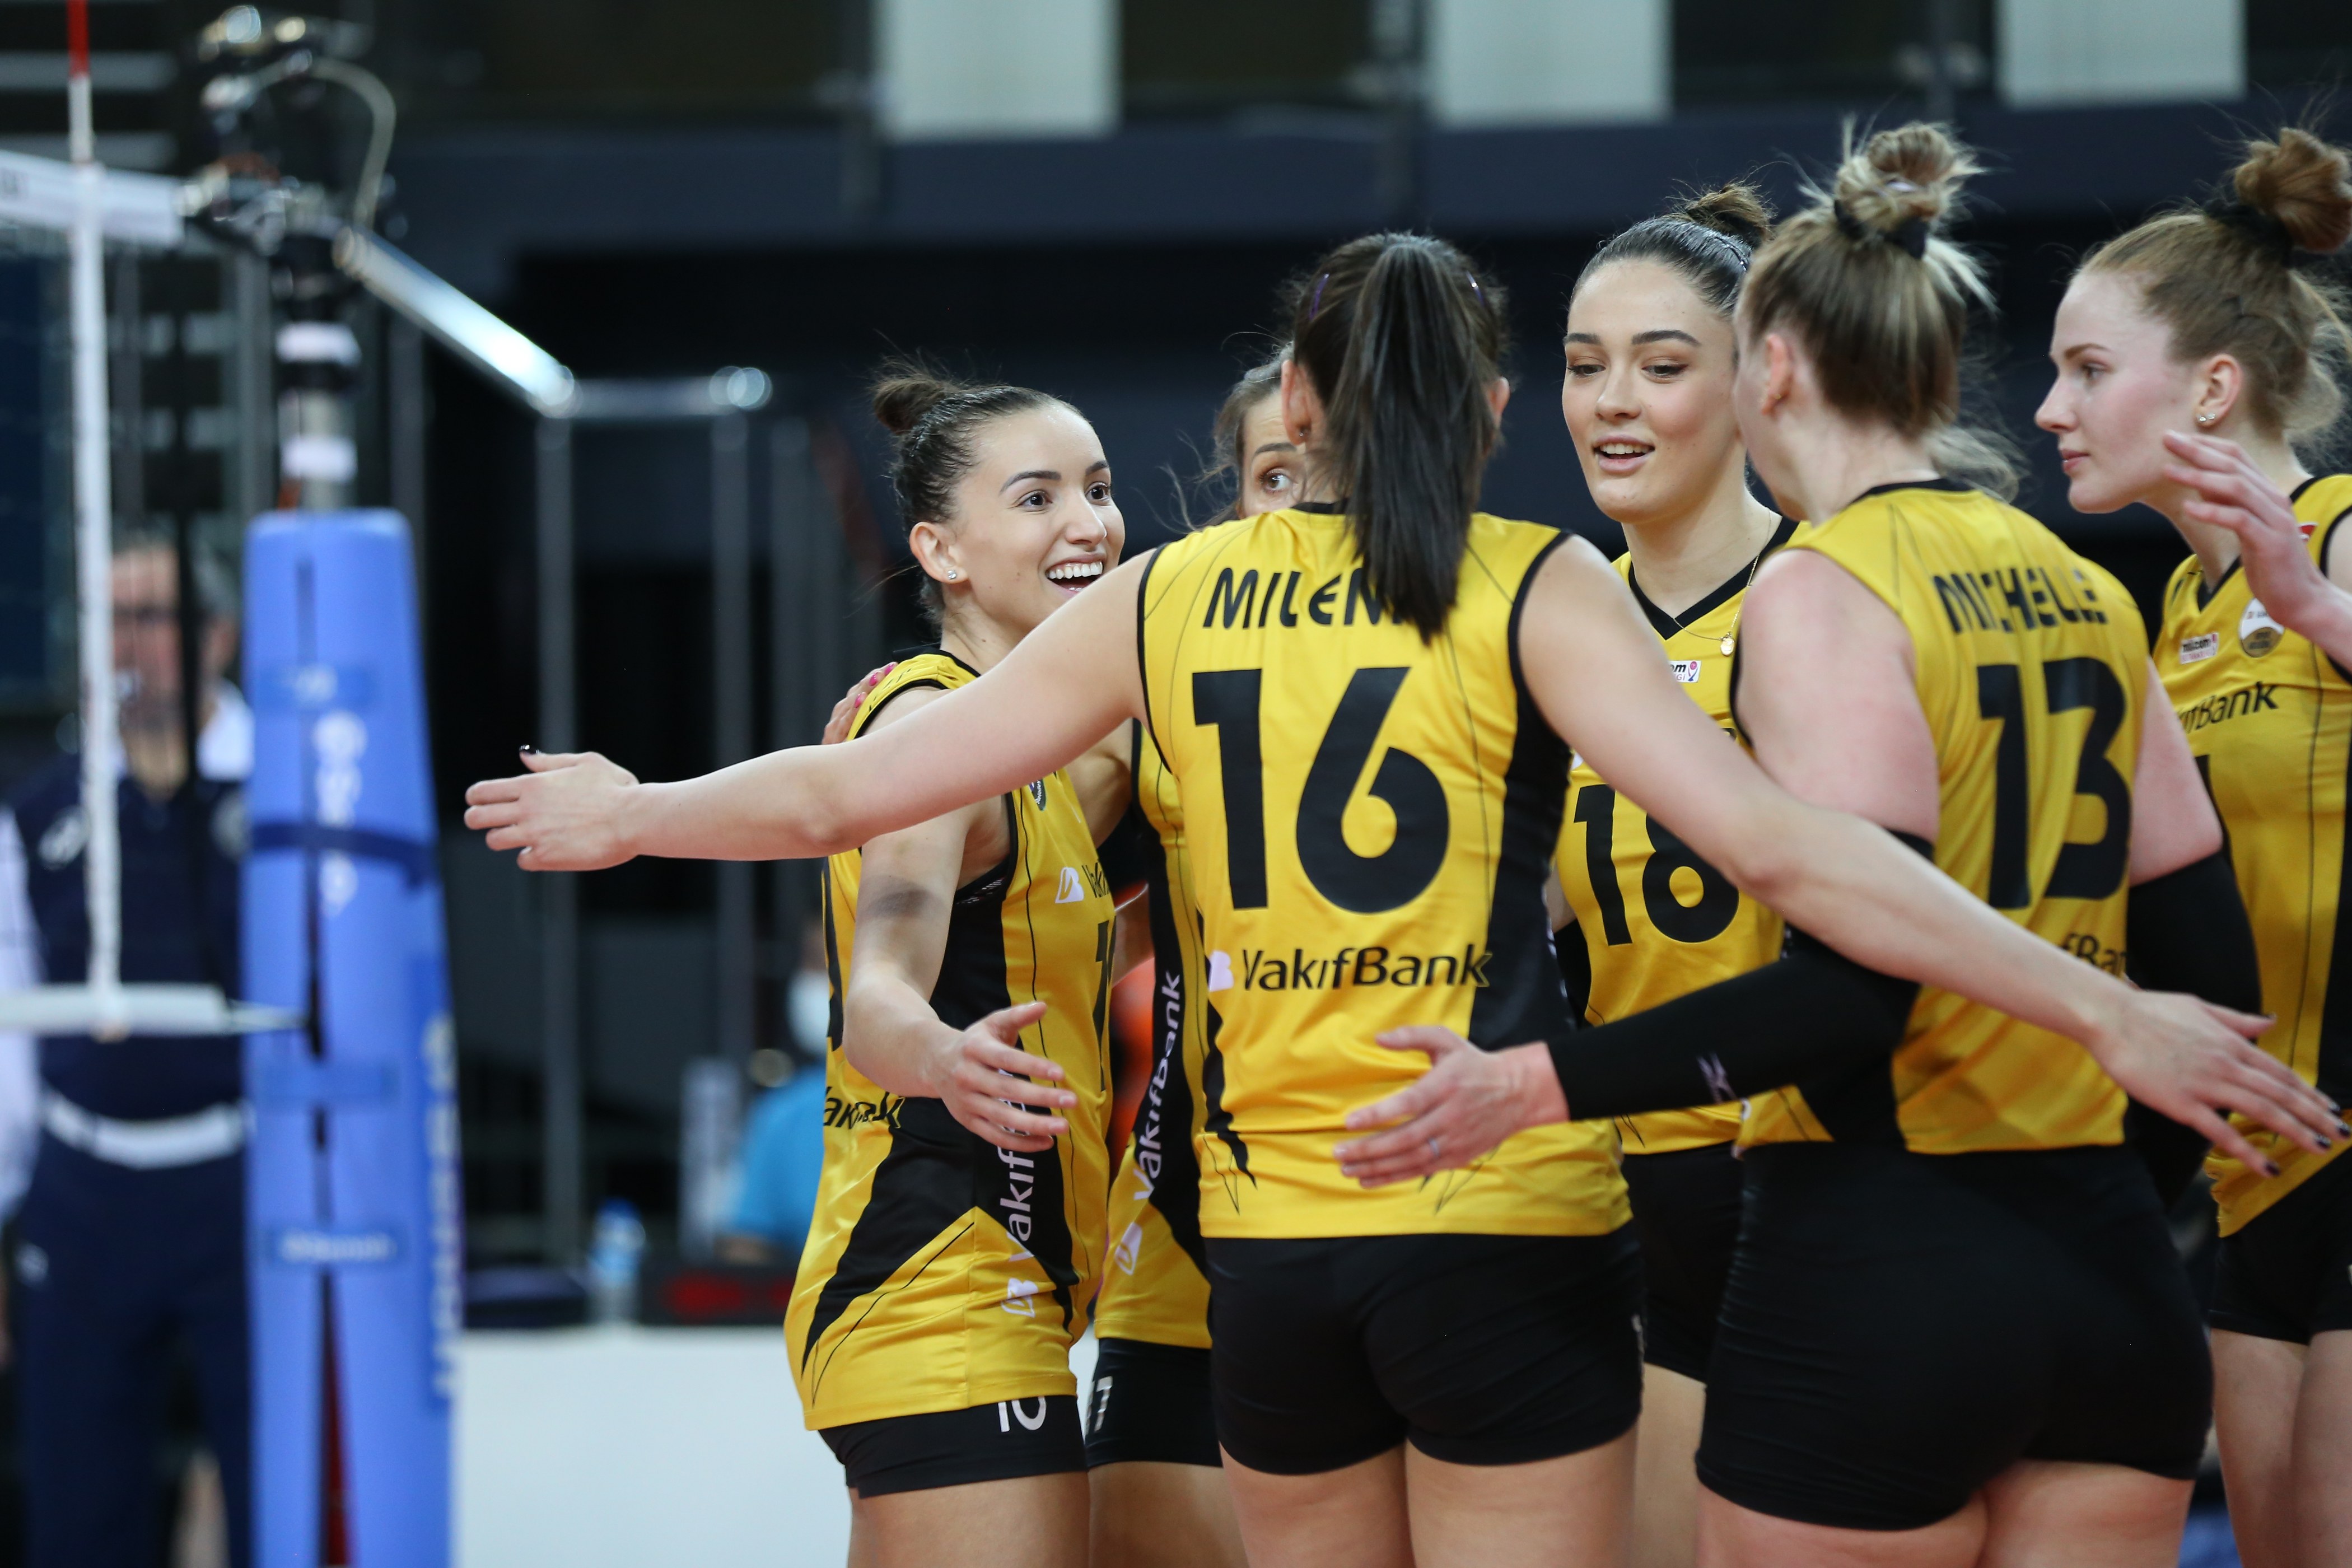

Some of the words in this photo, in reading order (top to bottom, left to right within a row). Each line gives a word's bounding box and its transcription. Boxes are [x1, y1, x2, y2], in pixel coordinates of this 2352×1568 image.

[1202, 567, 1403, 629] MILEN
[1192, 666, 1449, 915] 16
[1574, 783, 1740, 946] 18
[1977, 656, 2132, 910] 13
